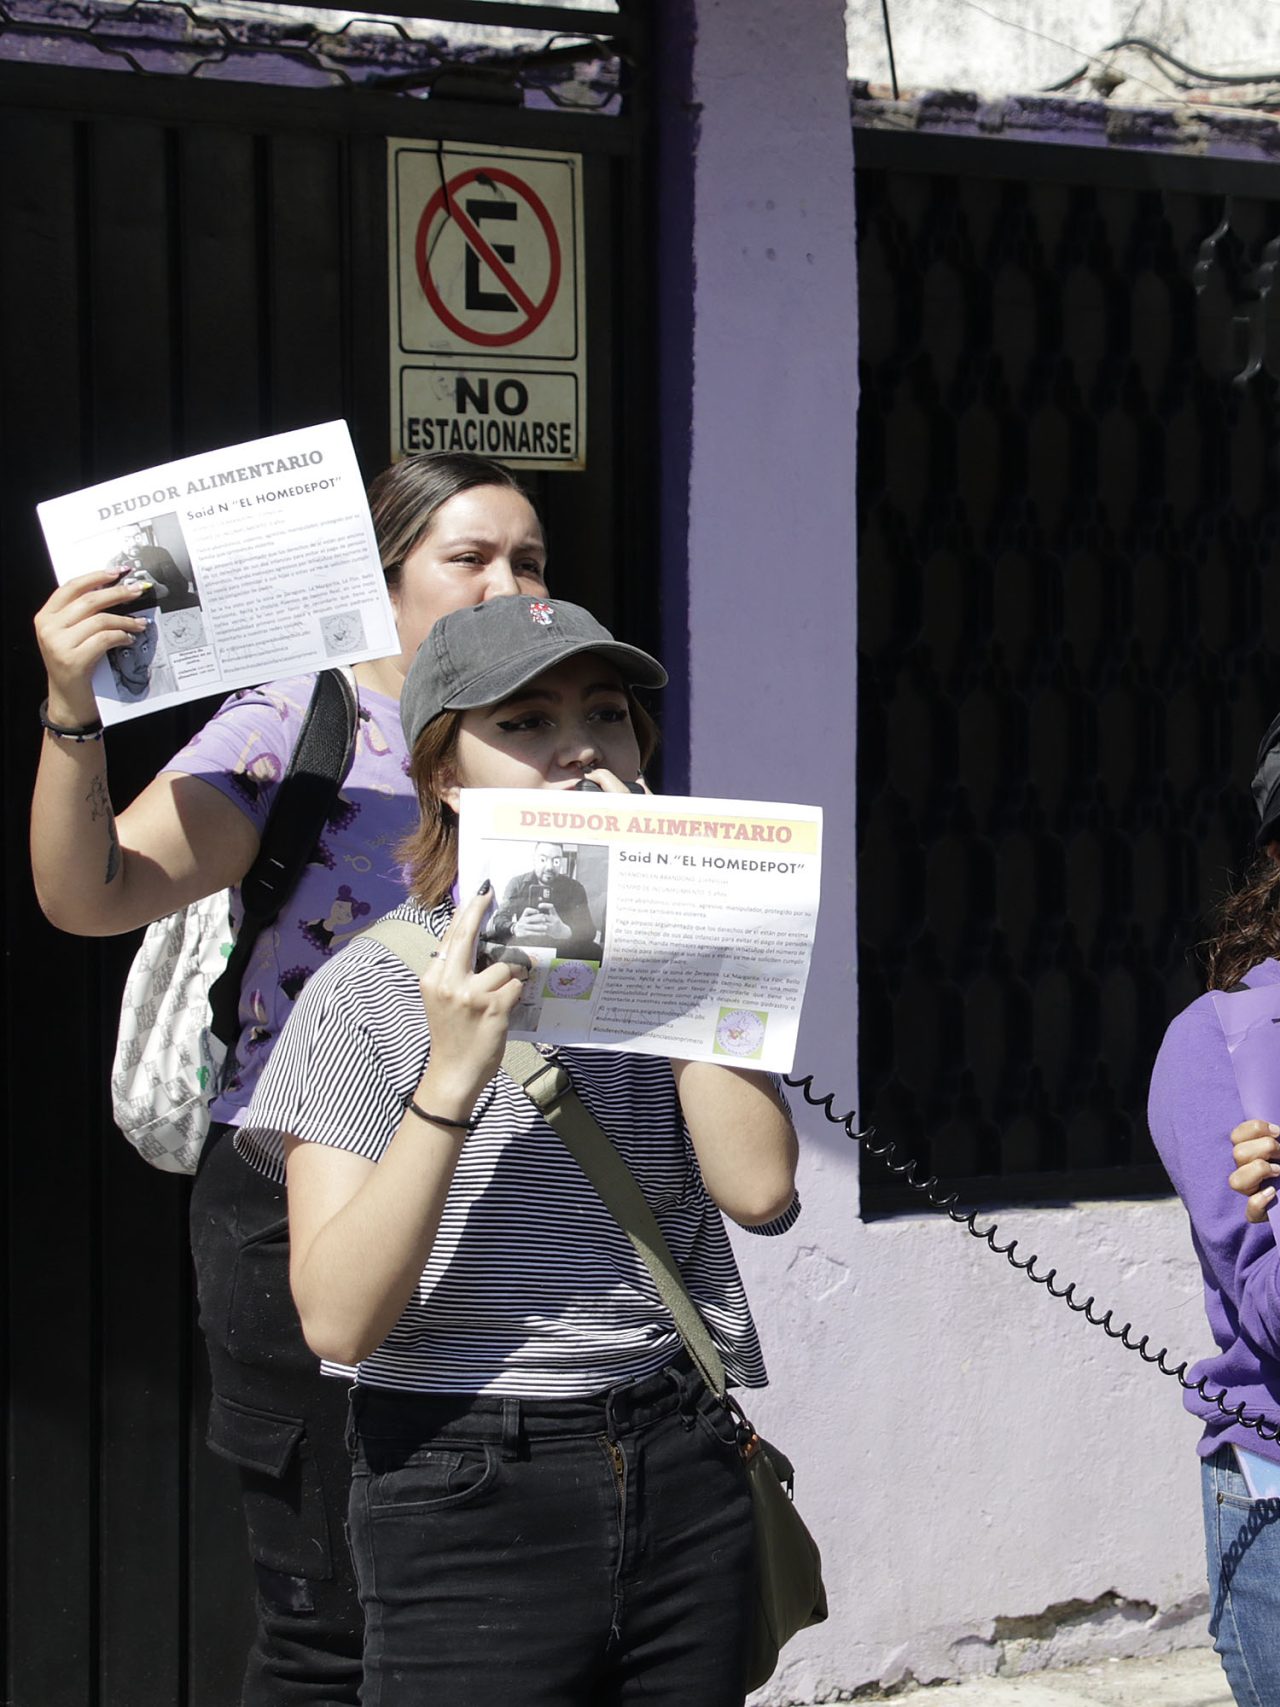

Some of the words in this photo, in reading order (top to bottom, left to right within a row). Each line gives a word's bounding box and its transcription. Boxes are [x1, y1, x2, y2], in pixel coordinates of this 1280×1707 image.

[465, 199, 518, 313] E
[456, 377, 528, 416] NO
[408, 417, 571, 454] ESTACIONARSE
[98, 486, 181, 521] DEUDOR
[186, 450, 324, 495] ALIMENTARIO
[187, 505, 215, 521] Said
[520, 810, 621, 832] DEUDOR
[626, 816, 793, 844] ALIMENTARIO
[619, 851, 652, 864] Said
